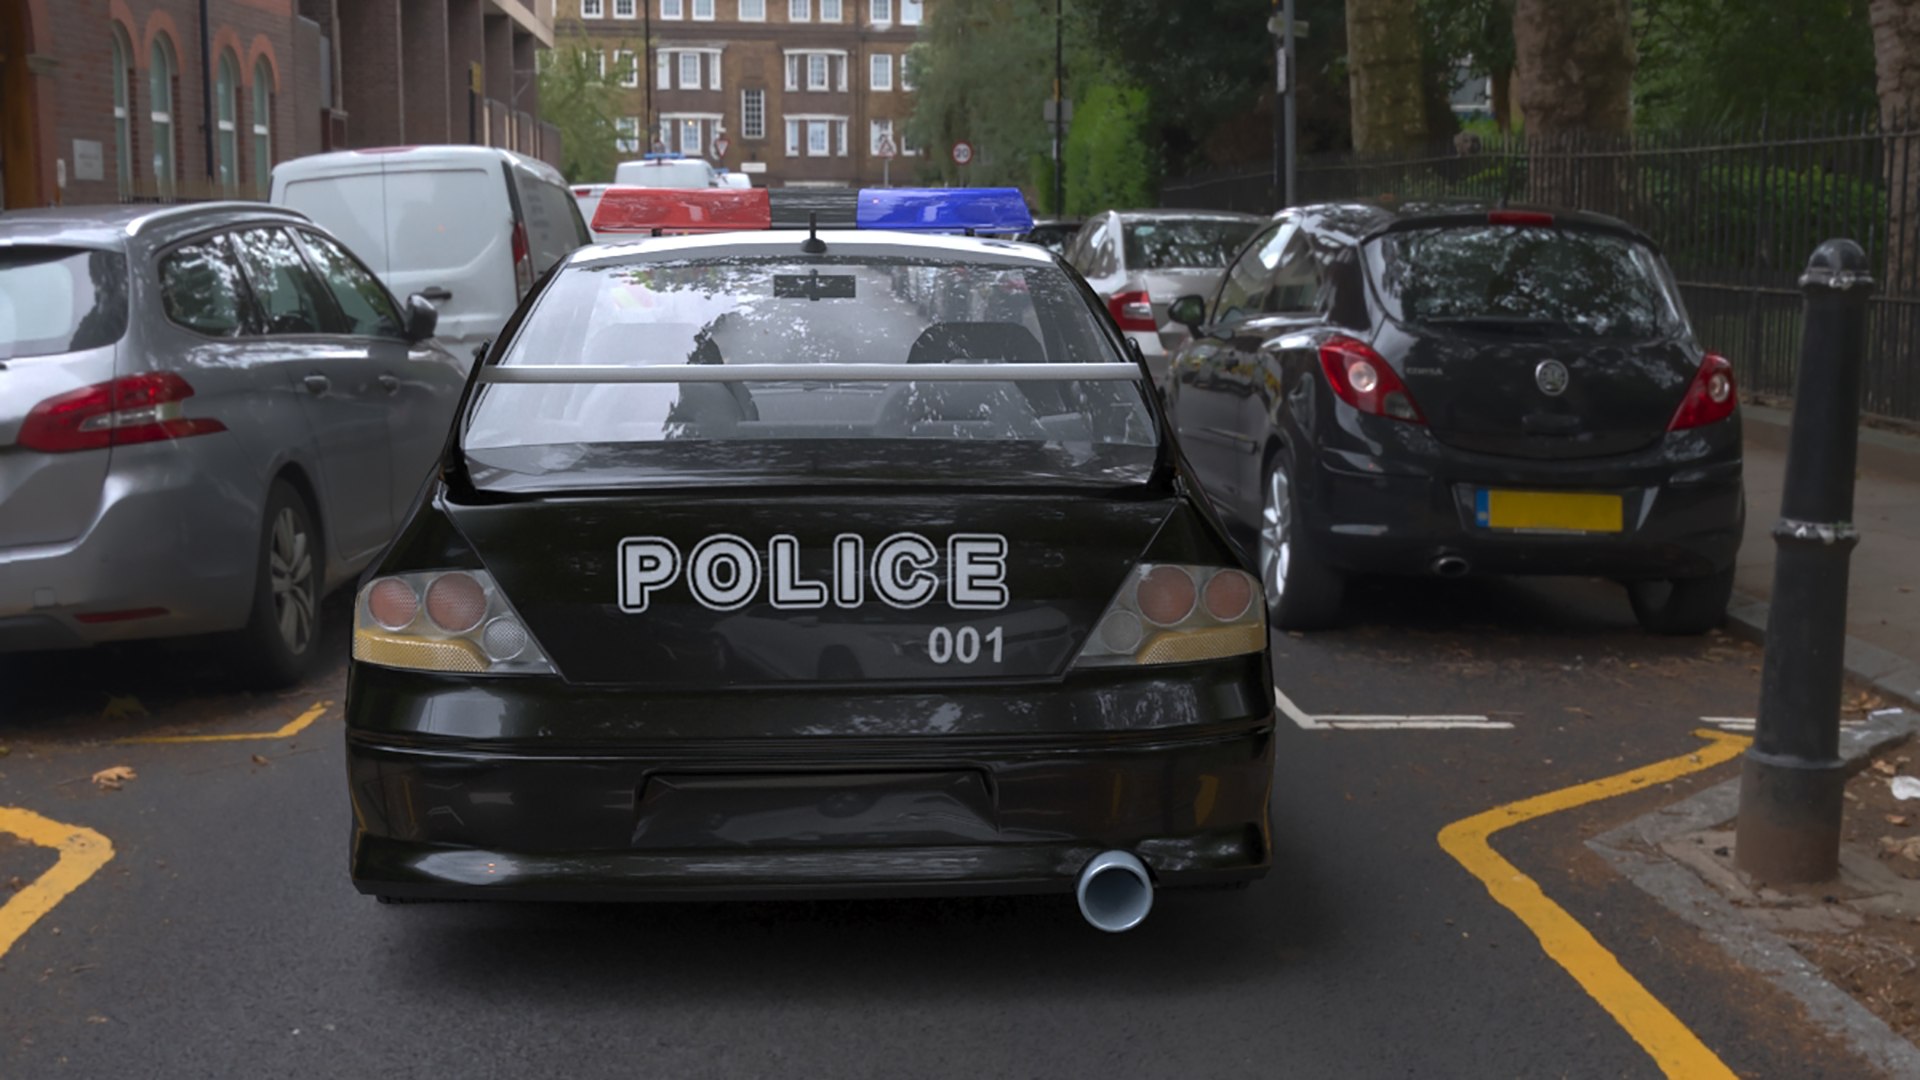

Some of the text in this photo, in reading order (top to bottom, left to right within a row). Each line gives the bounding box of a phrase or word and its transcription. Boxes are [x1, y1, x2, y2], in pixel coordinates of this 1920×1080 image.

[955, 147, 969, 159] 20
[618, 532, 1009, 613] POLICE
[929, 627, 1003, 663] 001
